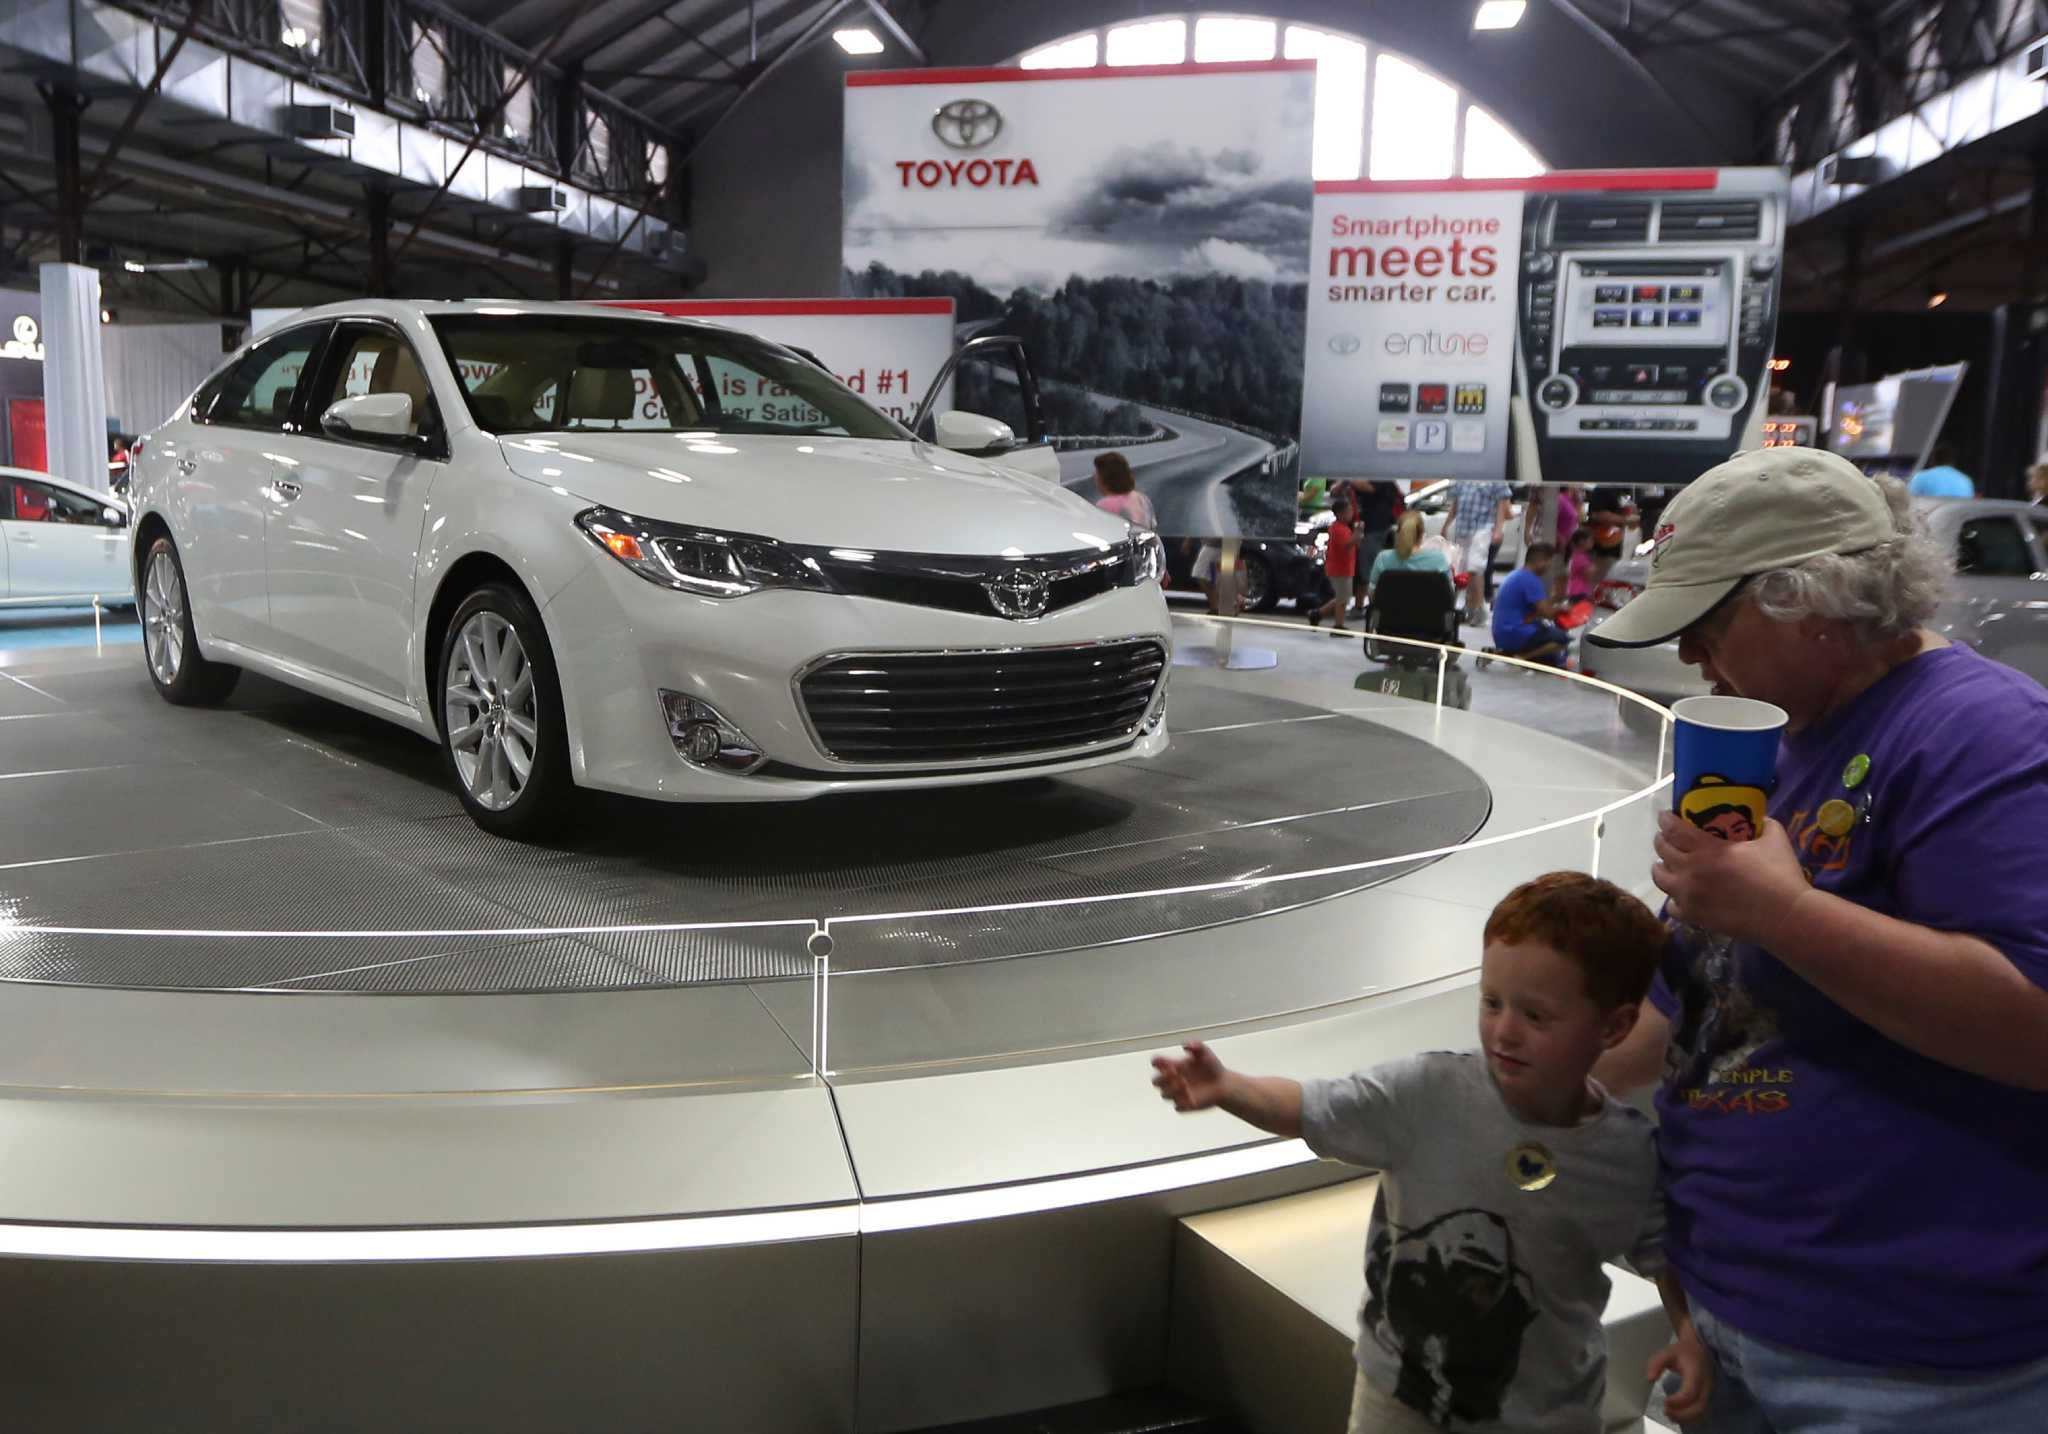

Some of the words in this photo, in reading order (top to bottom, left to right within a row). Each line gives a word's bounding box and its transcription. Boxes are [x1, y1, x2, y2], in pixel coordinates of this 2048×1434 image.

[895, 158, 1040, 188] TOYOTA
[1331, 213, 1501, 239] Smartphone
[1328, 237, 1498, 278] meets
[1328, 281, 1438, 302] smarter
[1446, 284, 1497, 302] car.
[1384, 329, 1489, 355] entune
[722, 373, 747, 396] is
[877, 369, 909, 394] #1
